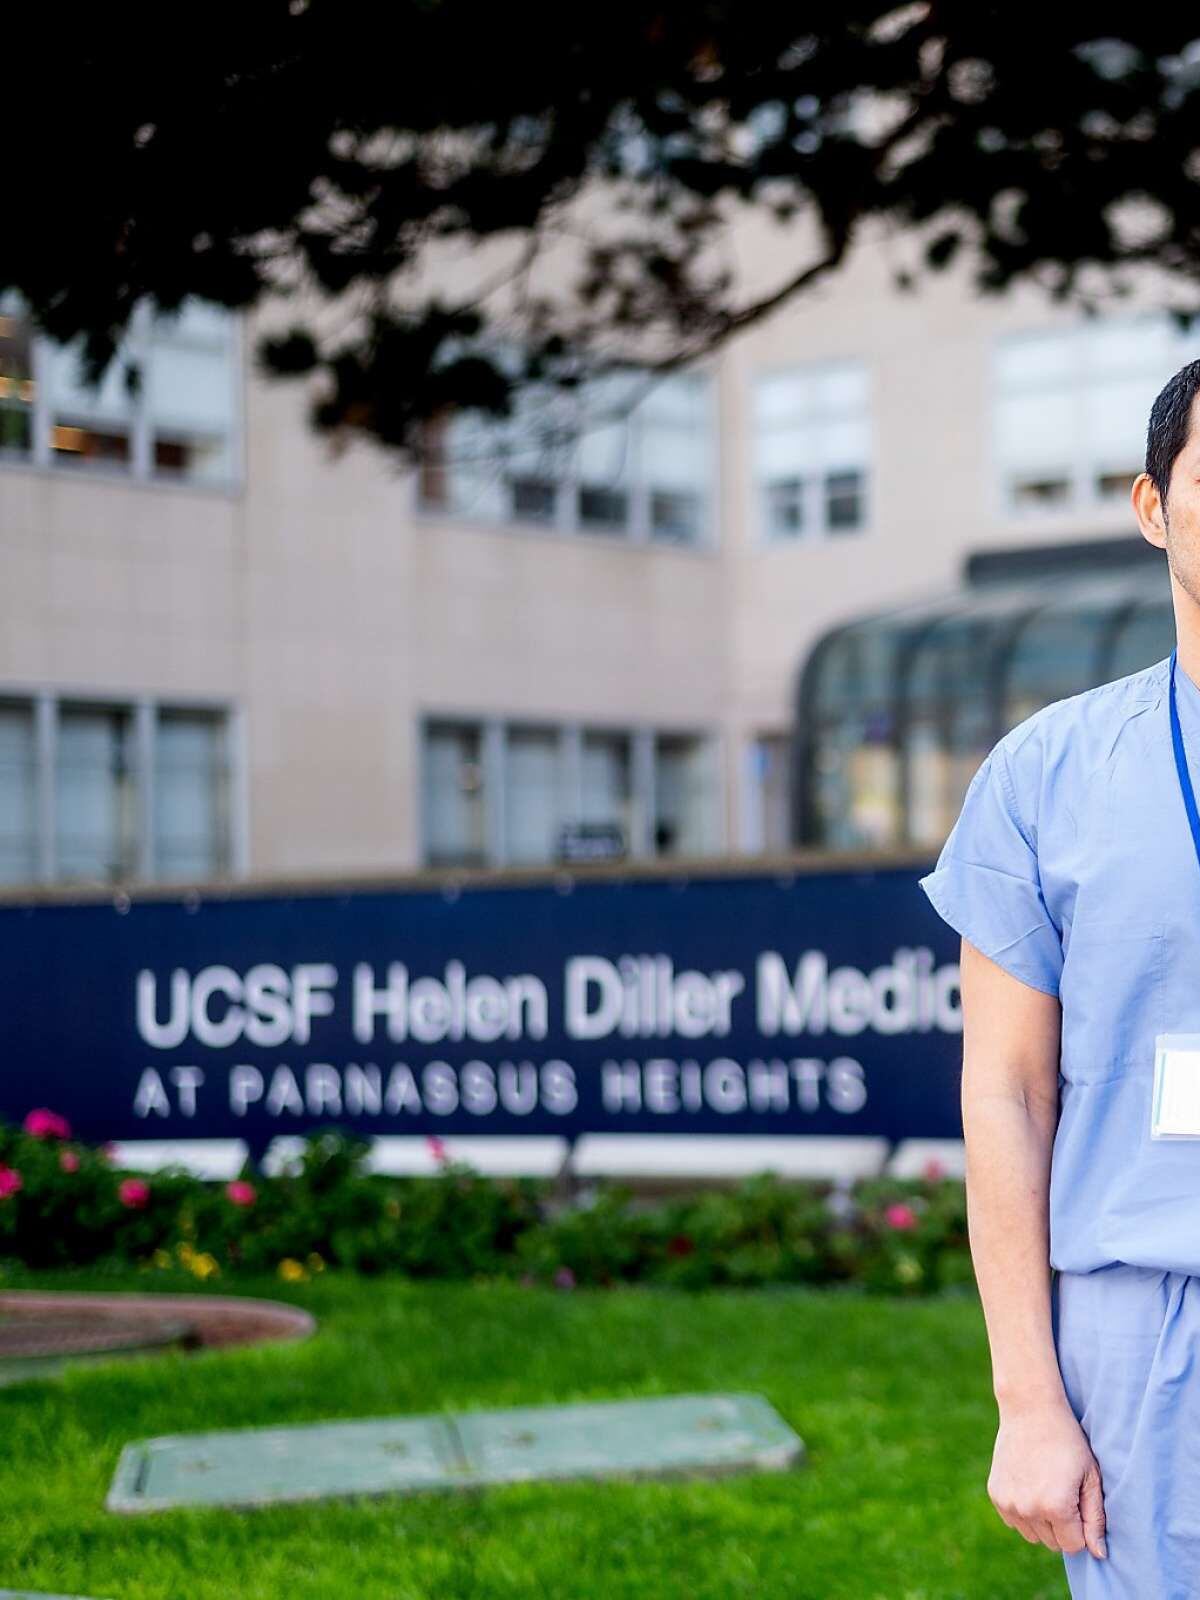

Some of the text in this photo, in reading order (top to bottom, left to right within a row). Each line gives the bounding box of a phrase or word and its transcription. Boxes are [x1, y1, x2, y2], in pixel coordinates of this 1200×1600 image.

[136, 947, 963, 1049] UCSF Helen Diller Medic
[134, 1055, 868, 1118] AT PARNASSUS HEIGHTS
